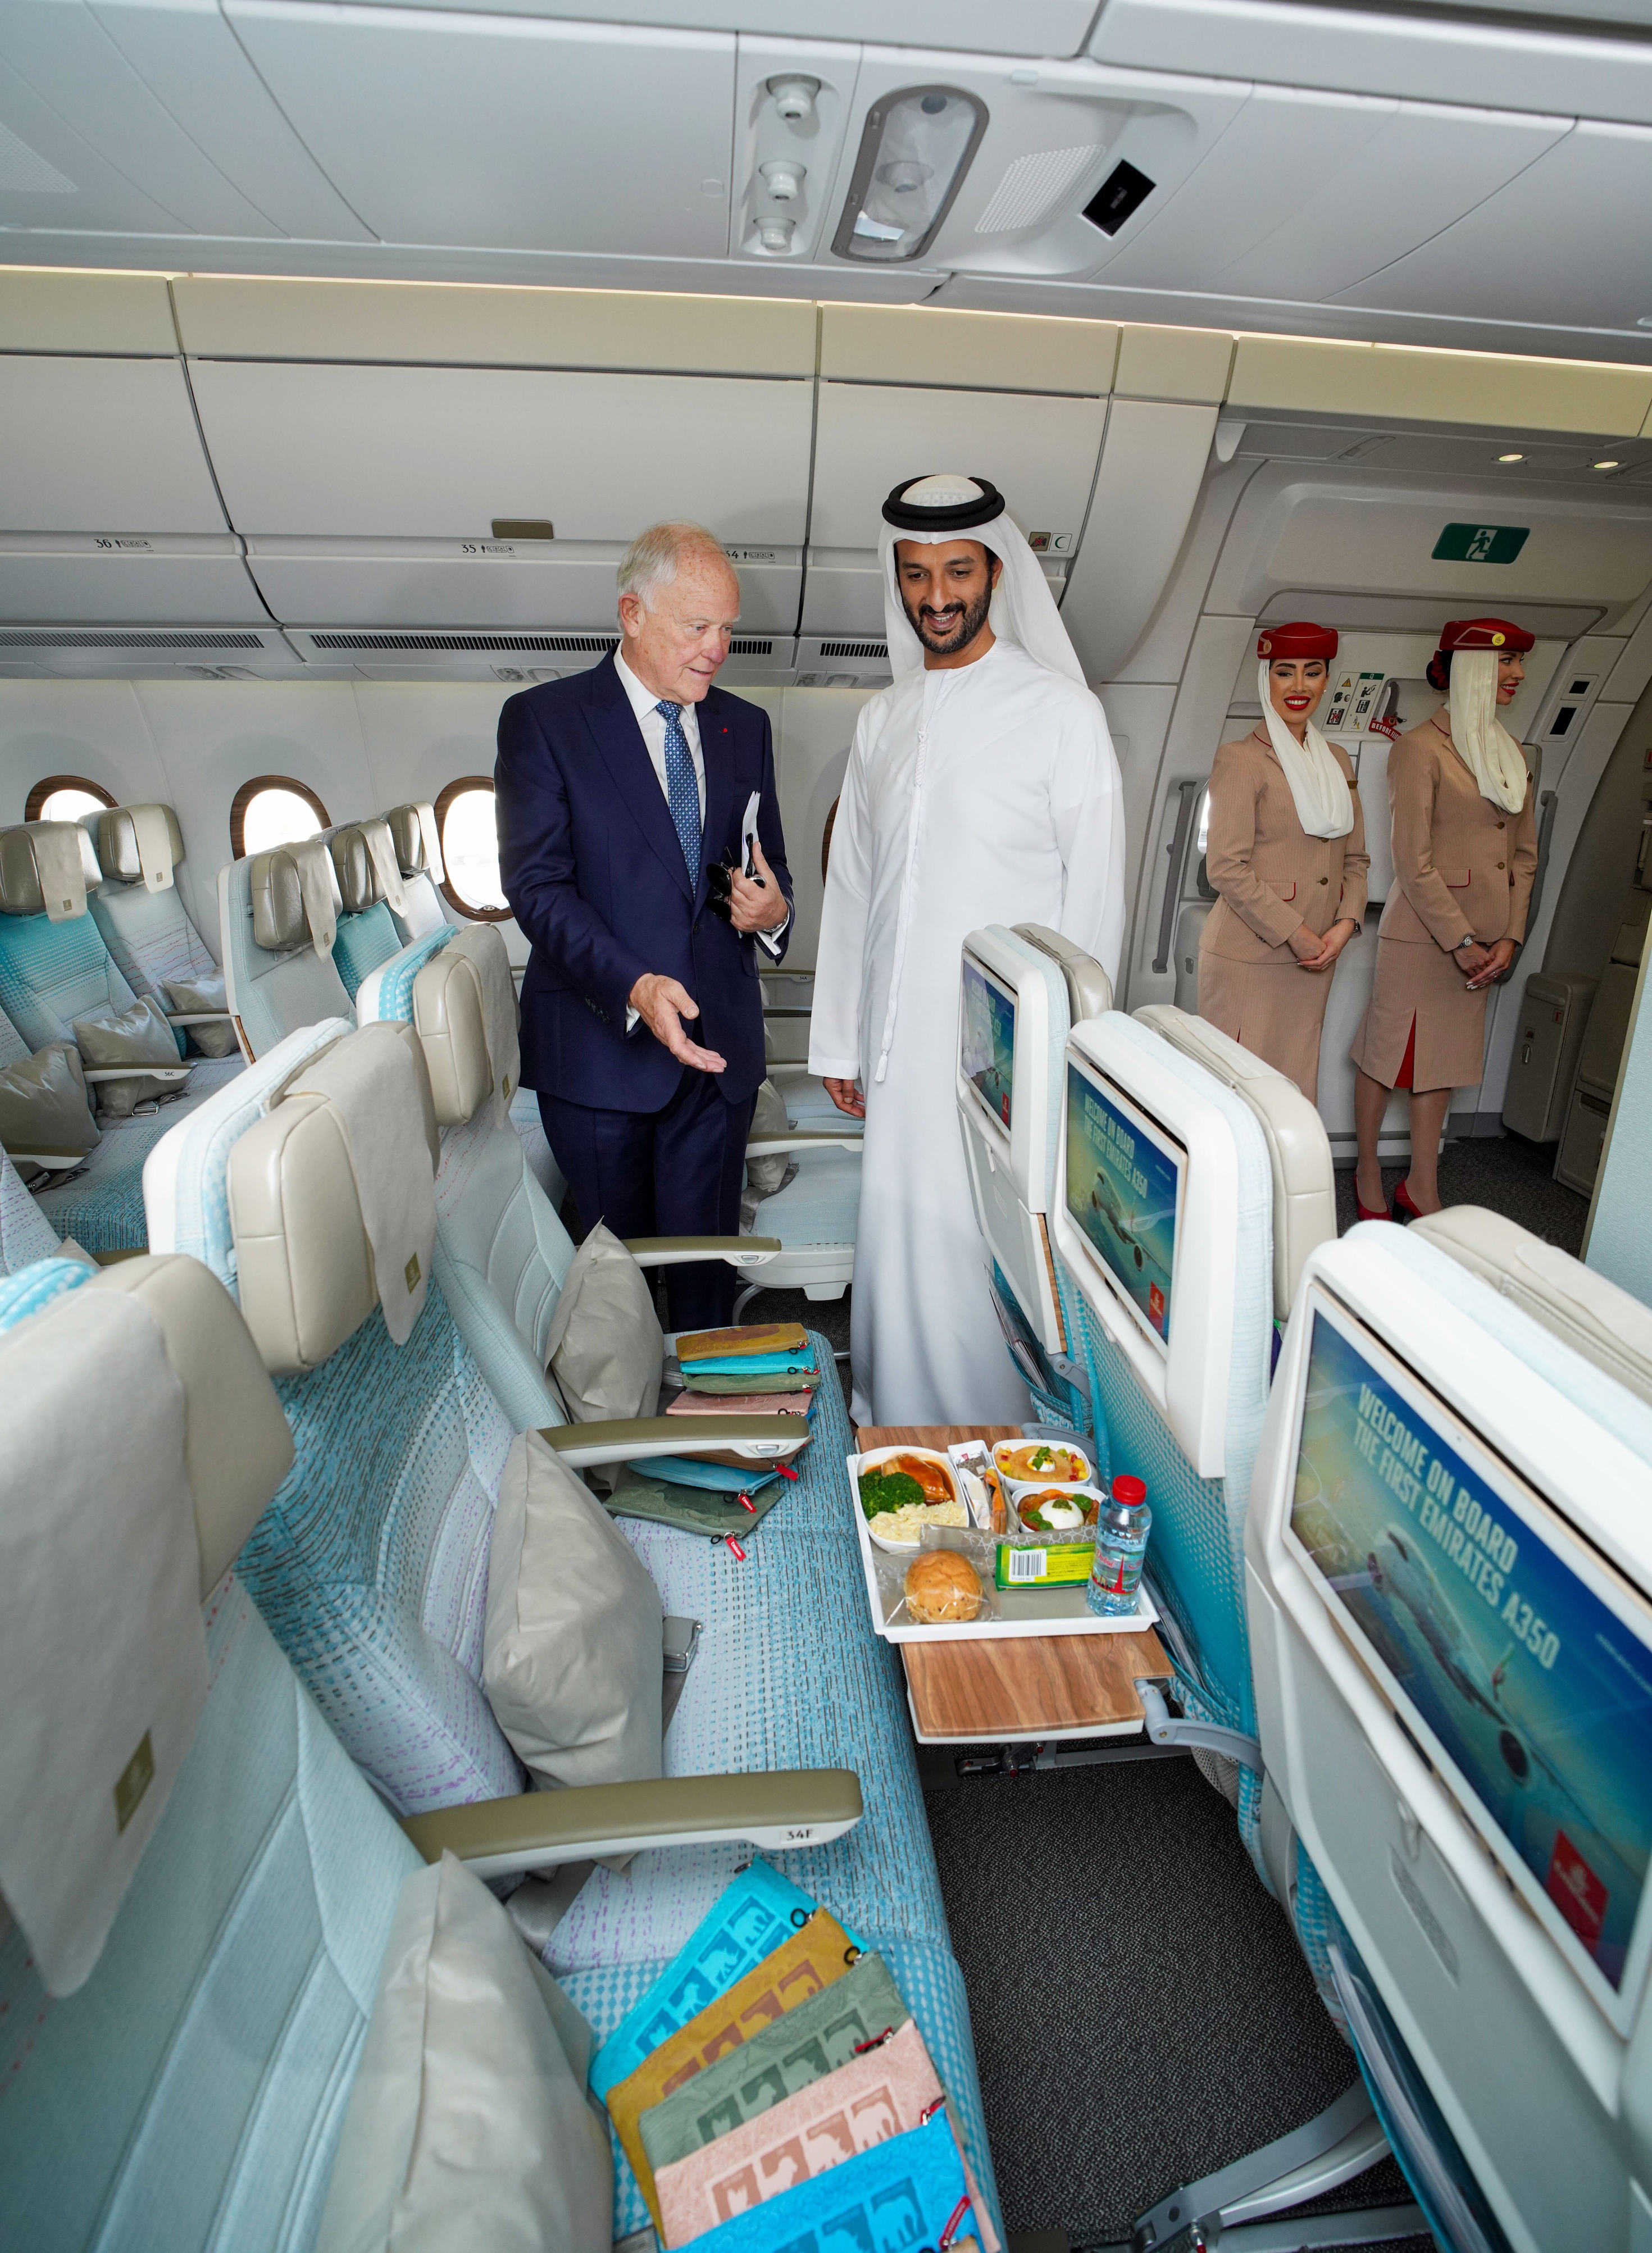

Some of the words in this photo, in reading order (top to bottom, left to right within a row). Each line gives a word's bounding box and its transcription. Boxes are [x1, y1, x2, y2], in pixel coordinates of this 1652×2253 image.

[94, 539, 112, 548] 36
[461, 544, 476, 553] 35
[1371, 722, 1391, 735] BEFORE
[1131, 1167, 1148, 1199] A350
[1359, 1383, 1429, 1478] WELCOME
[1426, 1459, 1455, 1508] ON
[1452, 1487, 1518, 1576] BOARD
[1354, 1418, 1381, 1465] THE
[1378, 1451, 1422, 1513] FIRST
[1419, 1494, 1505, 1608] EMIRATES
[1501, 1592, 1561, 1671] A350
[786, 1828, 813, 1841] 34F
